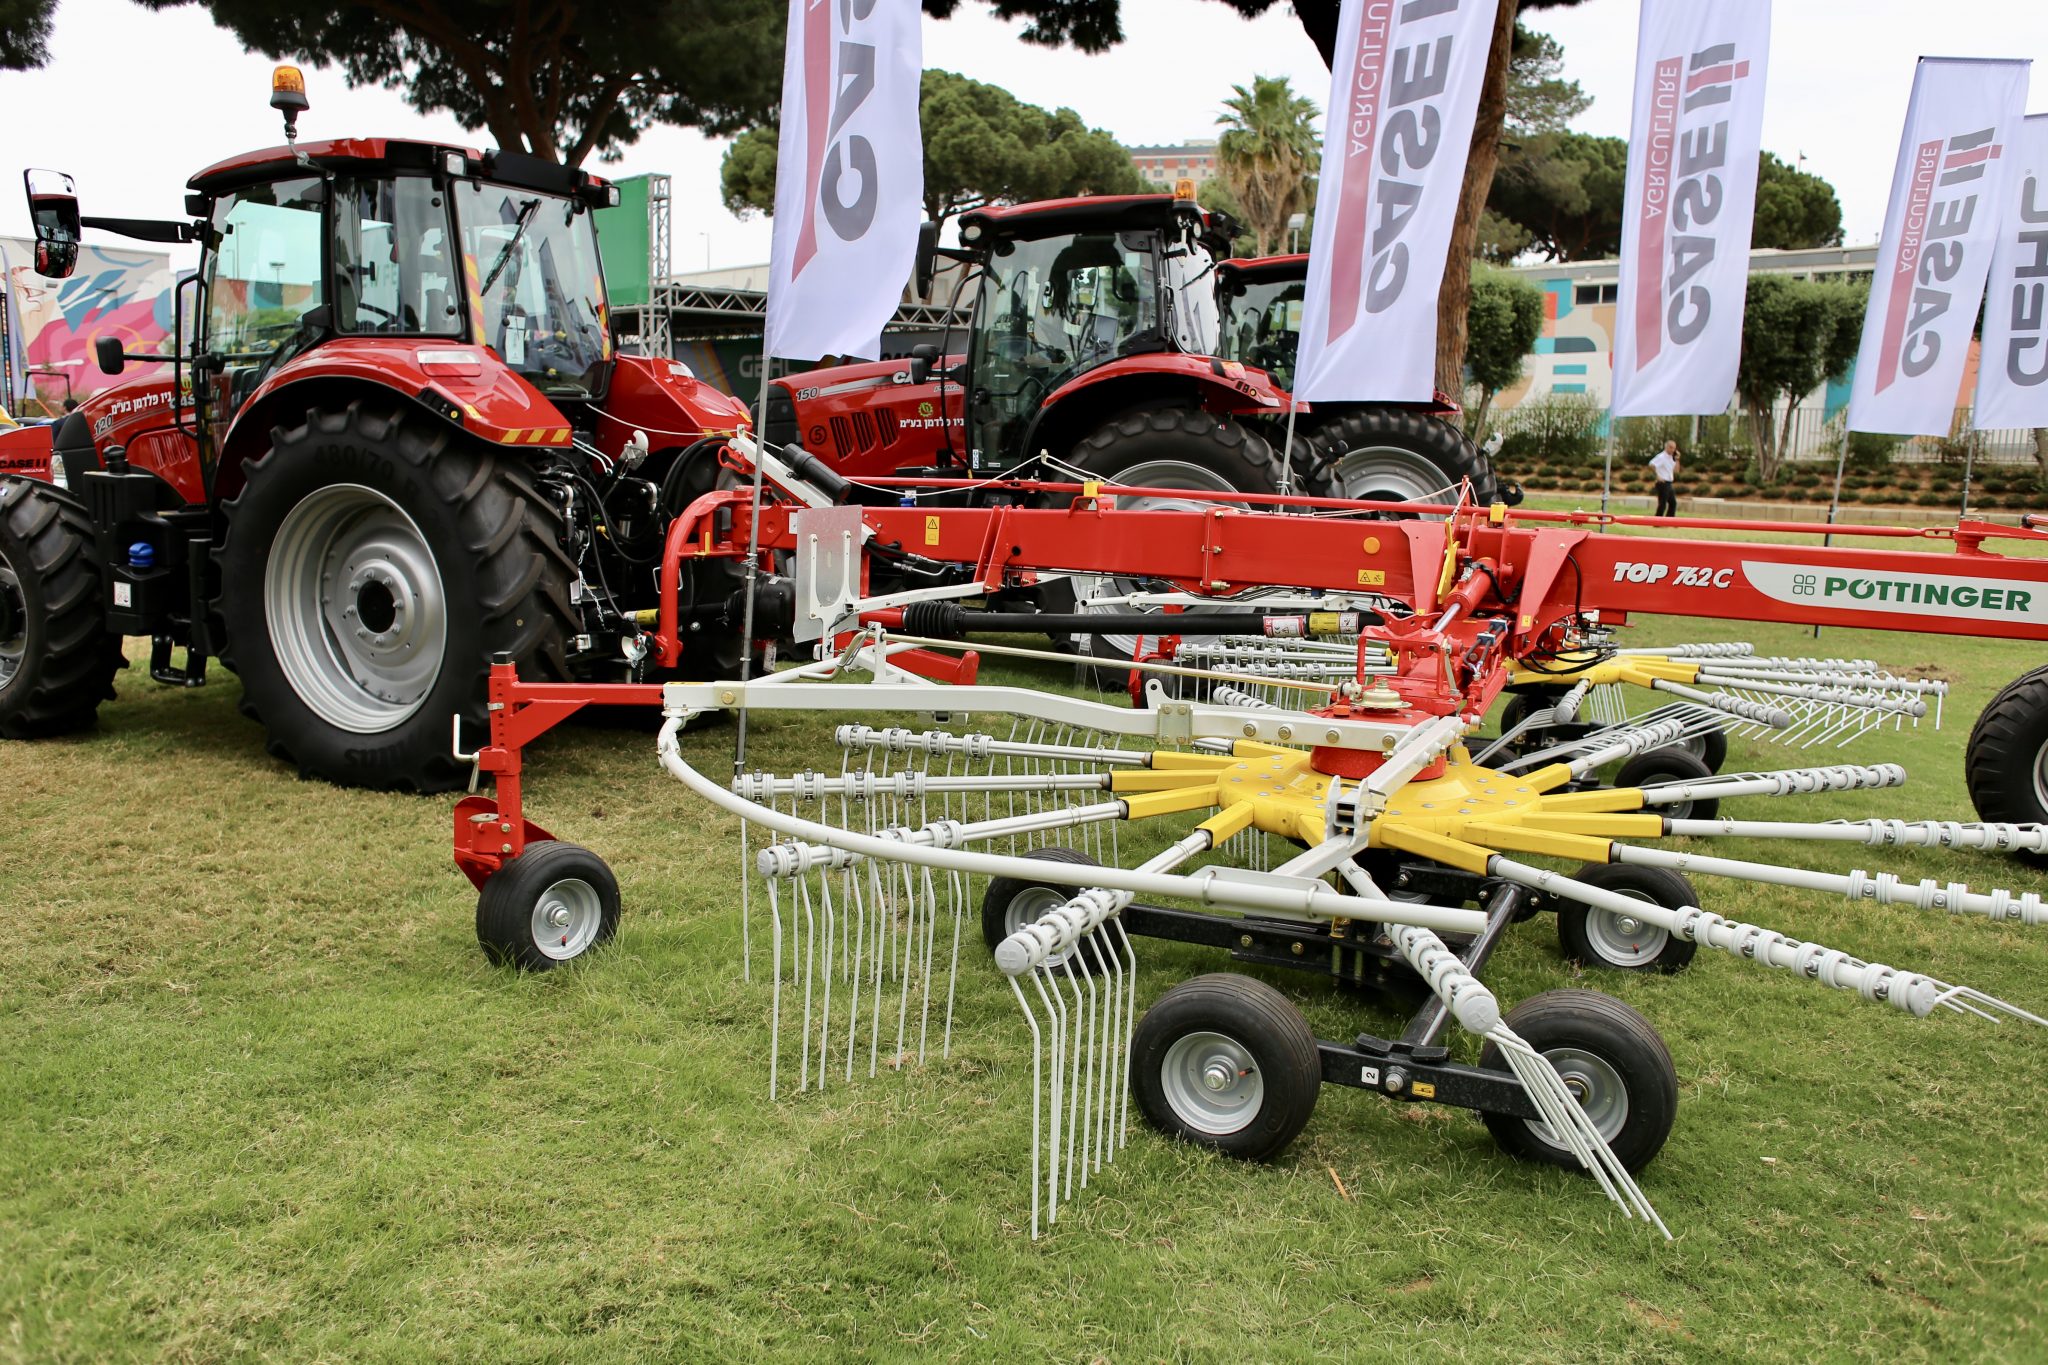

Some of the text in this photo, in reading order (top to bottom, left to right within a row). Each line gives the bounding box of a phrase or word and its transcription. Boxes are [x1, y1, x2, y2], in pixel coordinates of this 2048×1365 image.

[133, 393, 159, 412] פלדמן
[796, 387, 820, 401] 150
[94, 413, 113, 435] 120
[1613, 561, 1669, 584] TOP
[1823, 576, 2032, 612] PÖTTINGER
